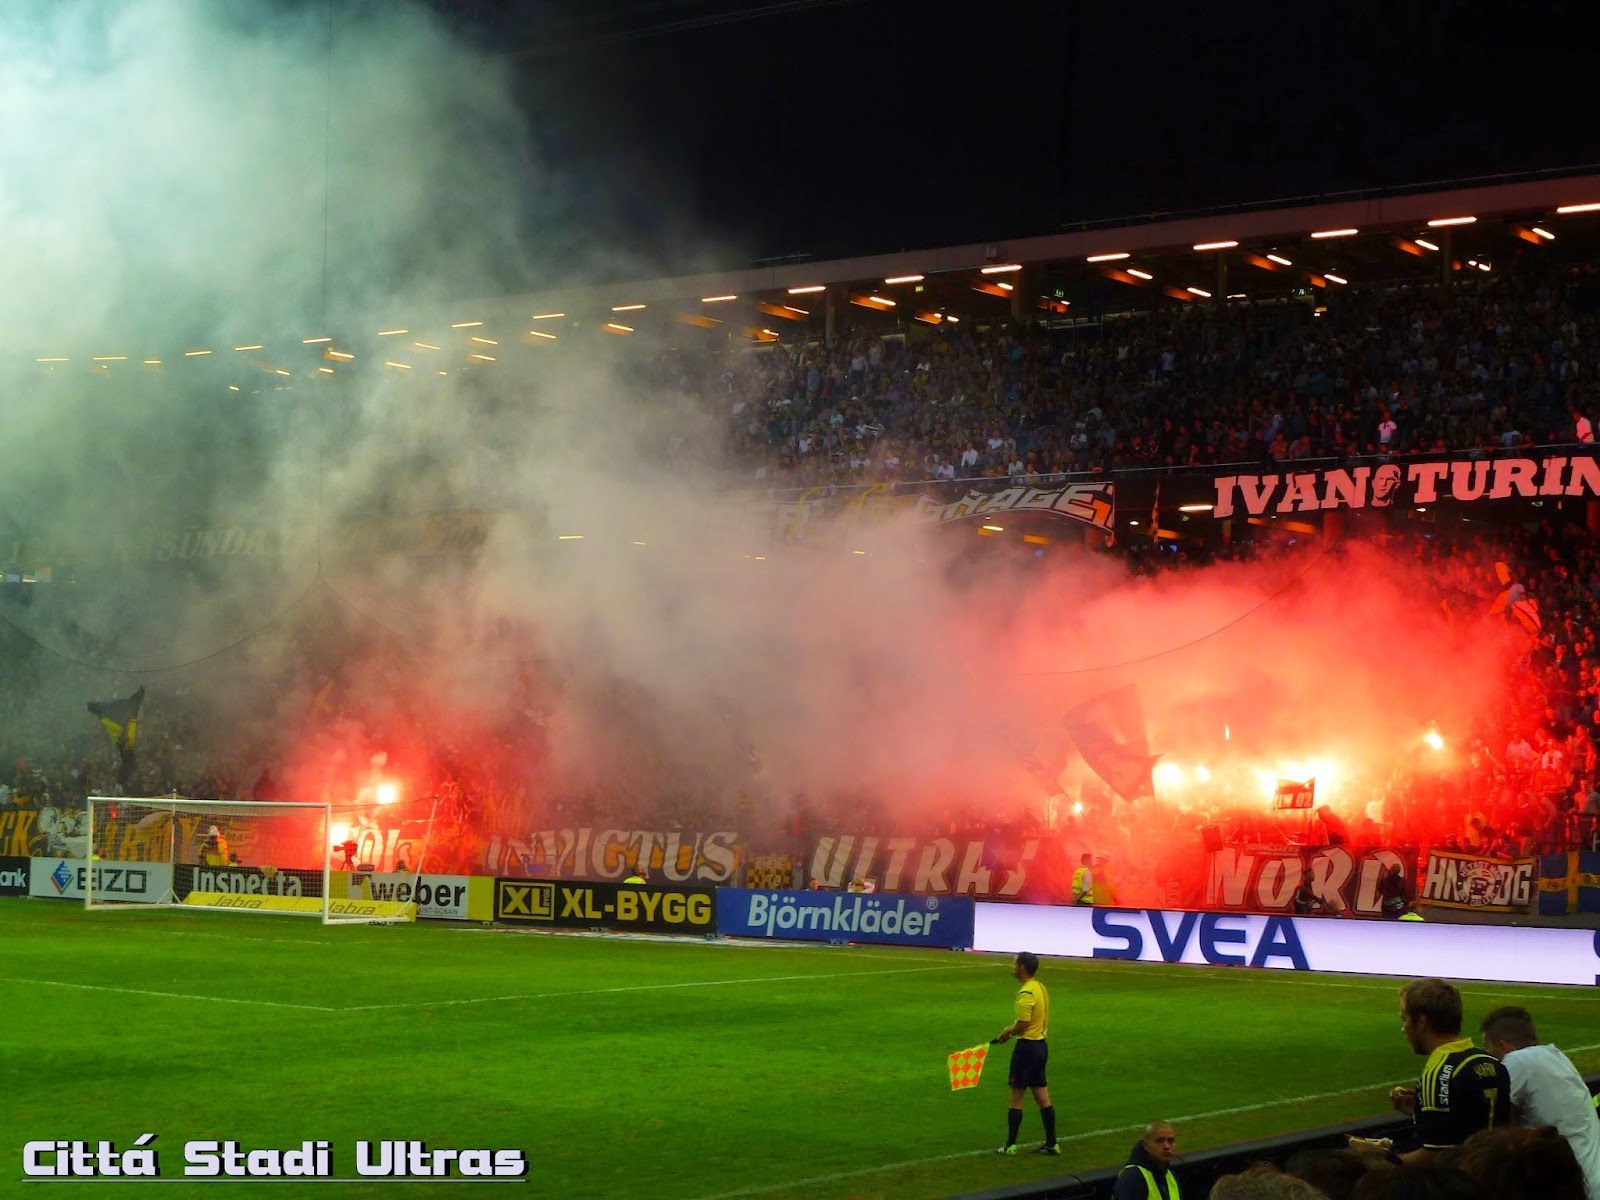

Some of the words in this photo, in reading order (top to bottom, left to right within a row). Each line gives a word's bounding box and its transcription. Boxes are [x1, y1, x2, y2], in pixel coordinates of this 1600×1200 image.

[1214, 467, 1371, 519] IVAN
[1407, 456, 1600, 503] TURIN
[482, 827, 738, 882] INVICTUS
[77, 867, 147, 893] EIZO
[371, 876, 465, 907] weber
[209, 895, 262, 909] Jabra
[416, 907, 459, 916] AINT-GOBAIN
[503, 886, 550, 915] XL
[561, 887, 711, 925] XL-BYGG
[747, 894, 939, 937] Björnkläder
[1092, 907, 1310, 970] SVEA
